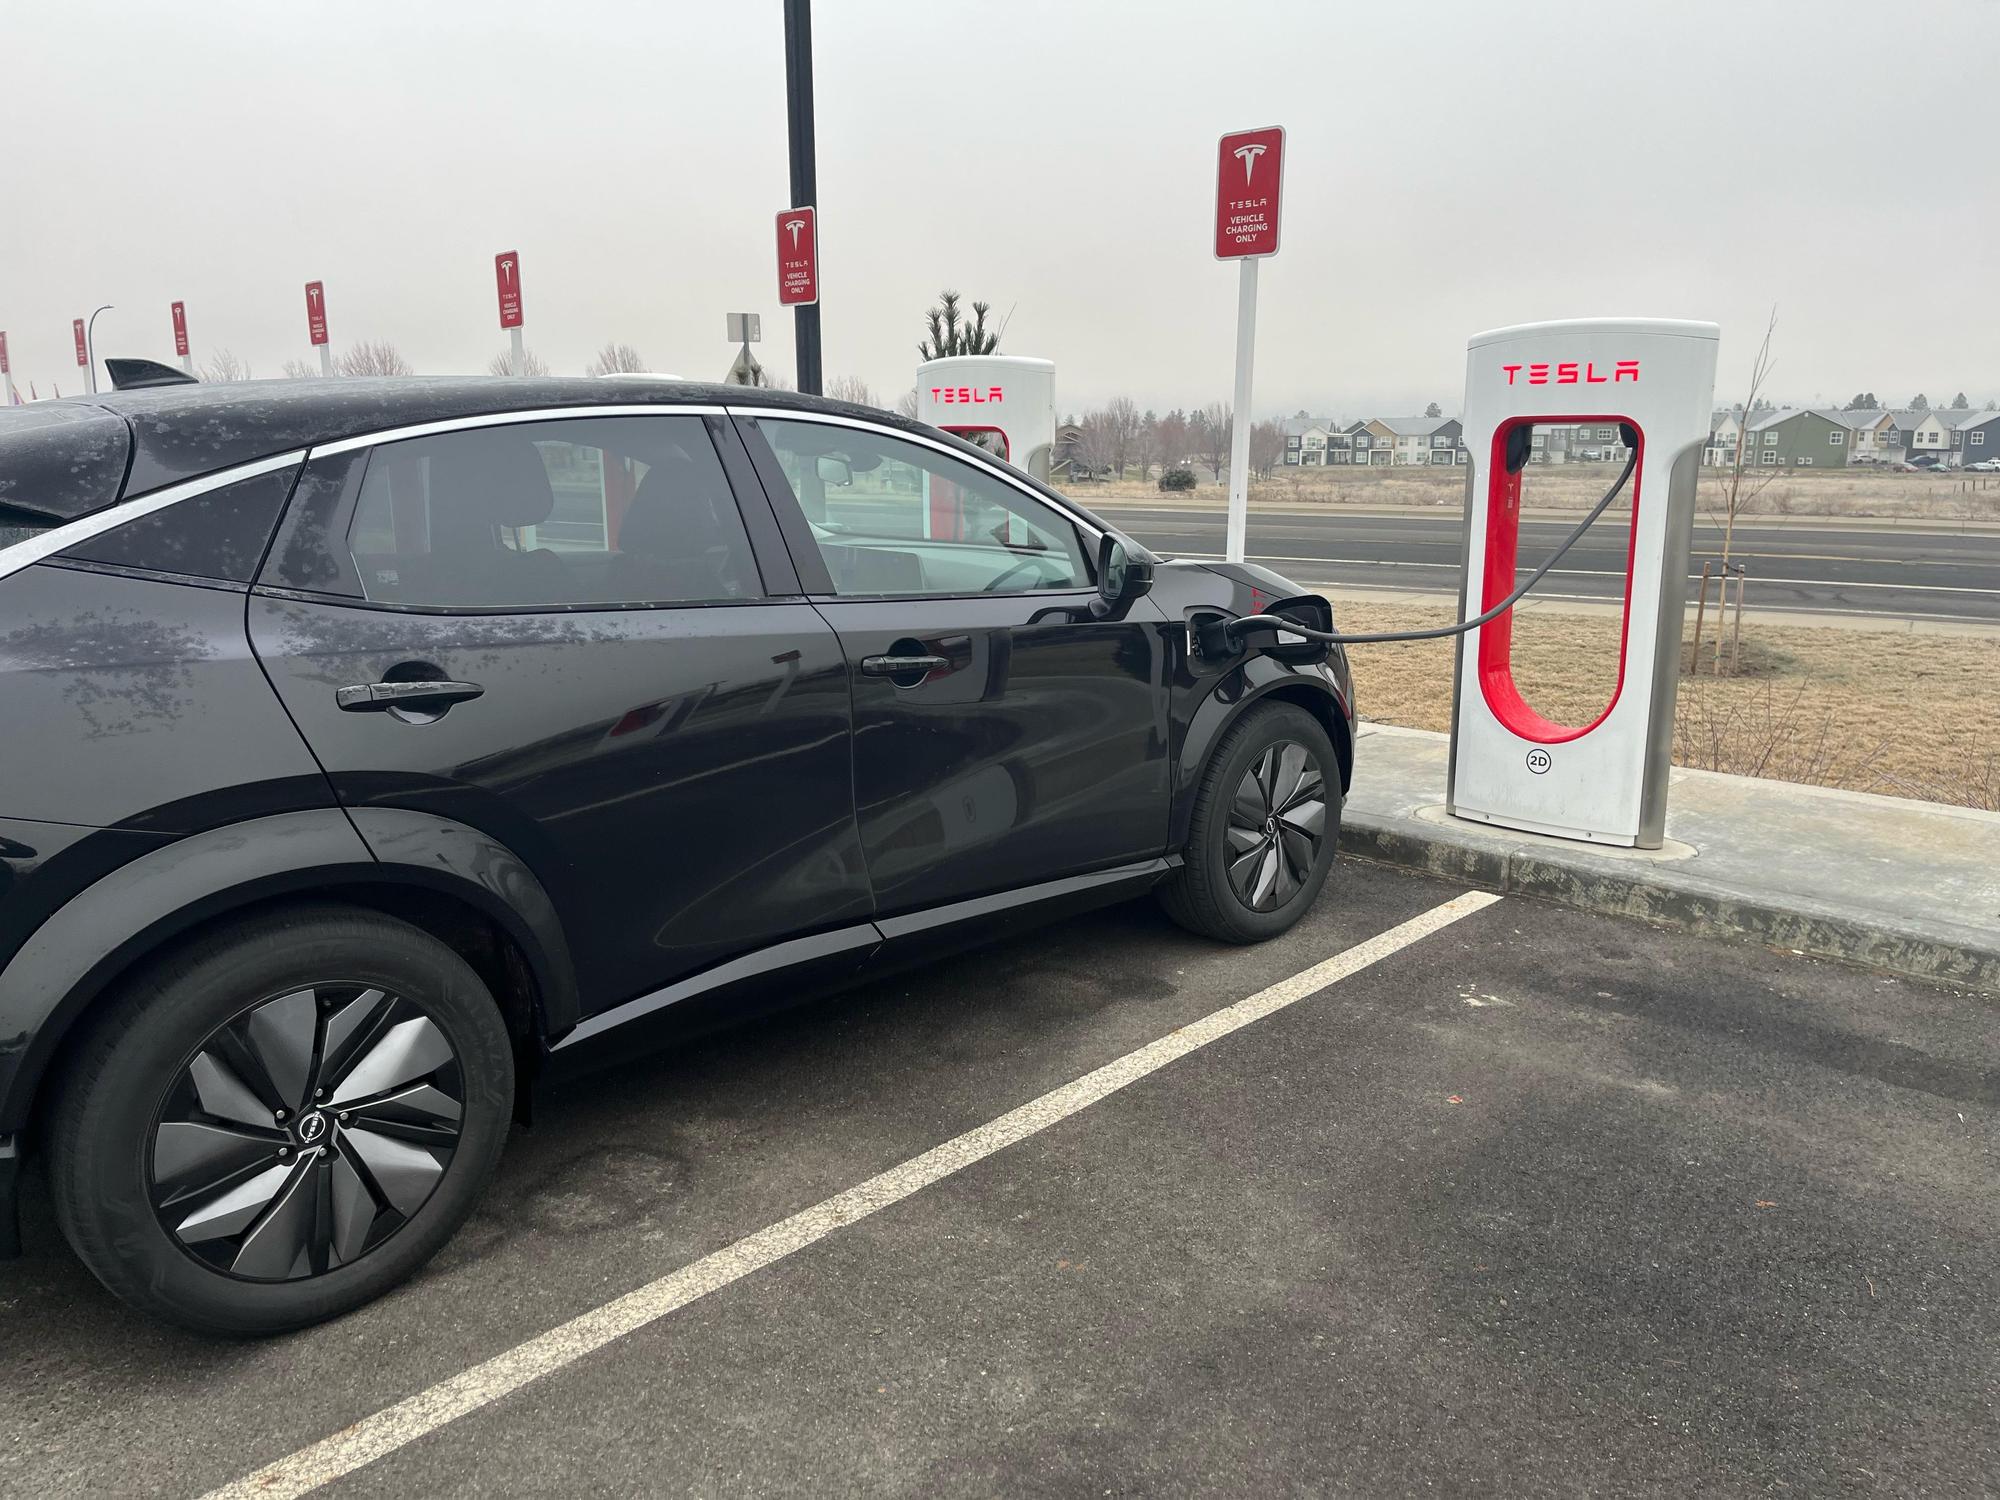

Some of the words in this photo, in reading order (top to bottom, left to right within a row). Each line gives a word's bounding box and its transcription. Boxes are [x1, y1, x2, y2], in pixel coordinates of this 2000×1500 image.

[1229, 198, 1267, 209] TESLA
[1230, 213, 1264, 224] VEHICLE
[1225, 222, 1268, 235] CHARGING
[1235, 233, 1257, 243] ONLY
[785, 260, 808, 269] TESLA
[787, 271, 808, 280] VEHICLE
[784, 278, 810, 287] CHARGING
[1502, 361, 1640, 386] TESLA
[931, 387, 1003, 404] TESLA
[1530, 755, 1548, 767] 2D
[304, 1111, 320, 1144] NISSAN
